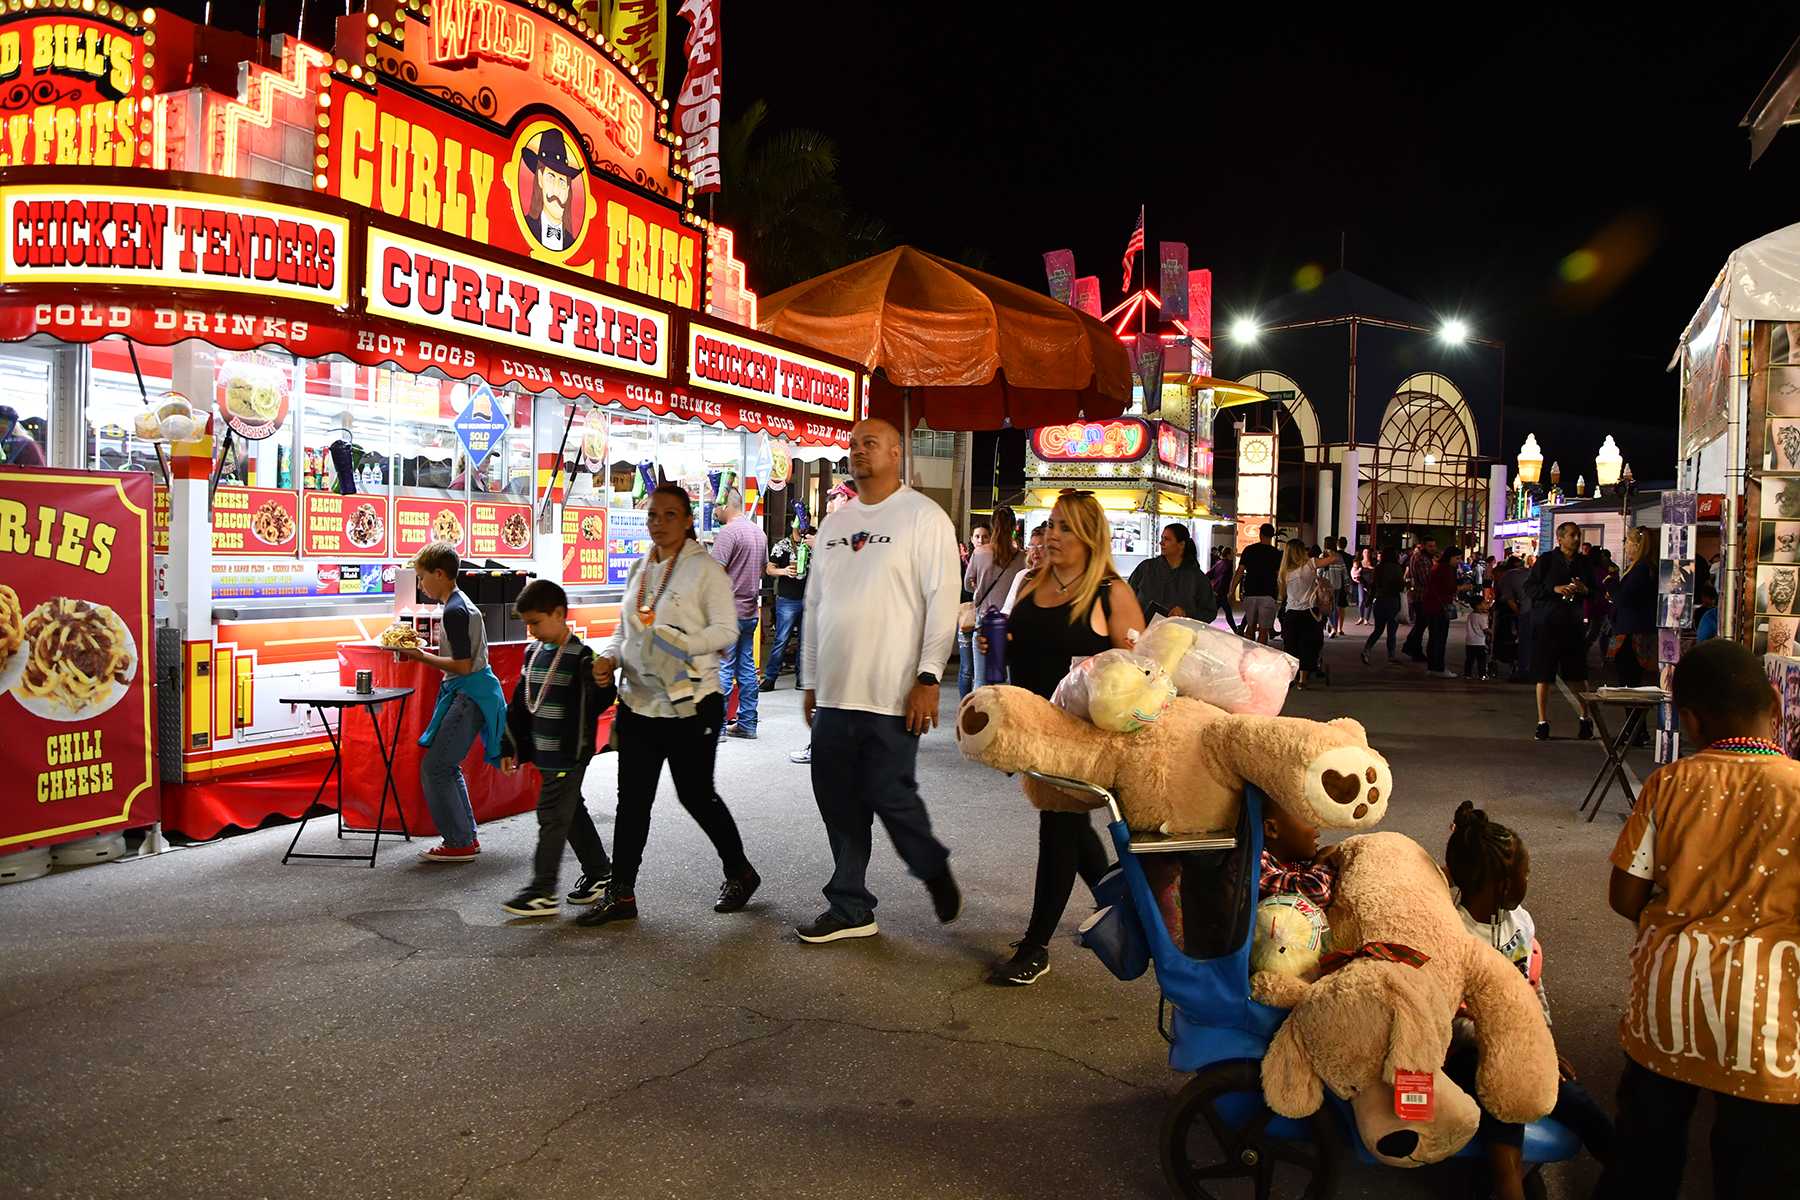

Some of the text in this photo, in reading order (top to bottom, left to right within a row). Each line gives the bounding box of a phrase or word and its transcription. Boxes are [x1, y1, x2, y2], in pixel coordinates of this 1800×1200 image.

[33, 24, 133, 96] BILL'S
[432, 0, 535, 62] WILD
[552, 33, 645, 156] BILL'S
[0, 97, 136, 166] Y FRIES
[340, 92, 695, 309] CURLY FRIES
[13, 200, 336, 290] CHICKEN TENDERS
[382, 246, 658, 365] CURLY FRIES
[35, 304, 309, 341] COLD DRINKS
[695, 334, 777, 395] CHICKEN
[780, 359, 849, 412] TENDERS
[356, 330, 852, 442] HOT DOGS CORN DOGS COLD DRINKS HOT DOGS CORN DO
[470, 431, 490, 441] SOLD
[469, 441, 489, 451] HERE
[213, 492, 249, 509] HEESE
[310, 497, 342, 513] BACON
[215, 512, 251, 528] BACON
[399, 511, 430, 526] CHEESE
[475, 507, 496, 520] CHILI
[310, 516, 343, 532] RANCH
[472, 523, 499, 537] CHEESE
[0, 499, 117, 575] RIES
[211, 532, 245, 549] FRIES
[312, 535, 340, 550] FRIES
[401, 529, 426, 543] FRIES
[474, 539, 497, 553] FRIES
[580, 549, 604, 563] CORN
[581, 565, 603, 579] DOGS
[47, 730, 102, 766] CHILI
[37, 762, 113, 803] CHEESE
